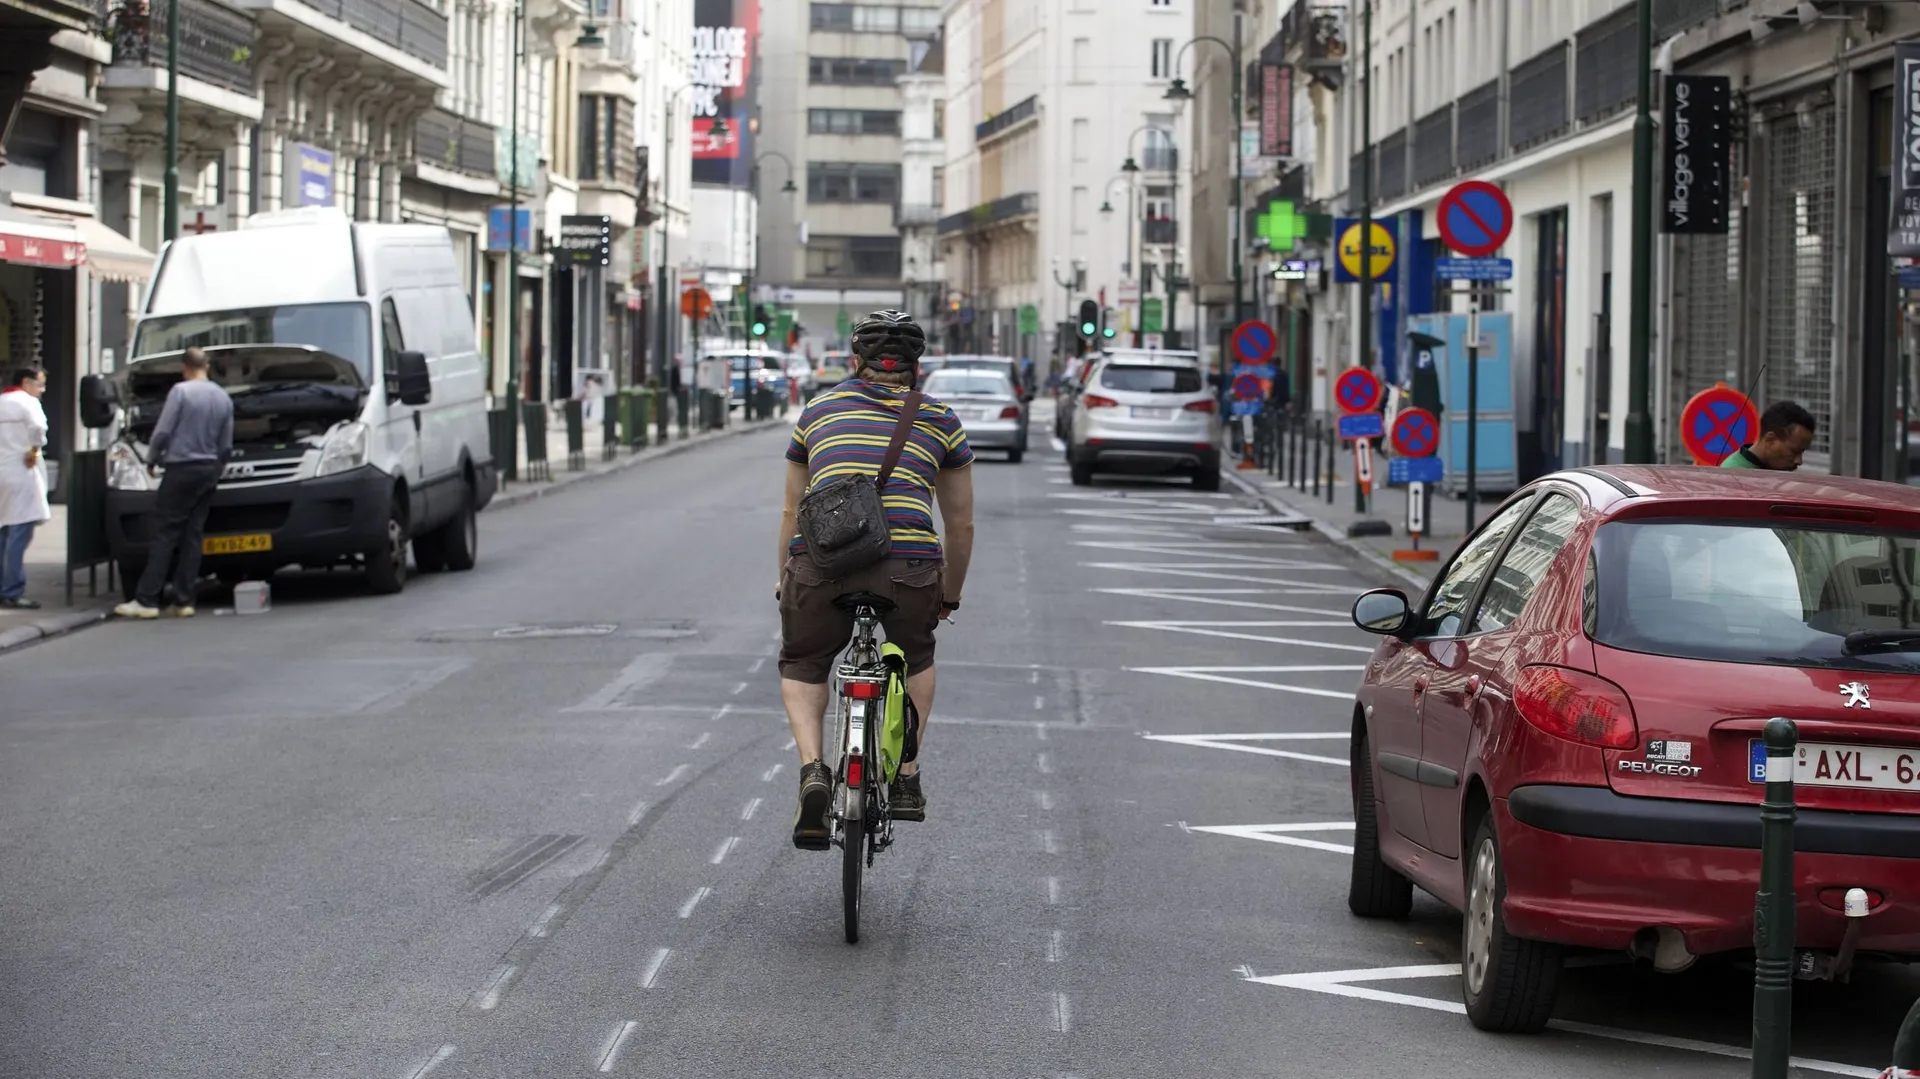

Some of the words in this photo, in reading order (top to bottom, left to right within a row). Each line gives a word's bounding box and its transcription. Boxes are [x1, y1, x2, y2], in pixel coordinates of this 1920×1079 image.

[1675, 82, 1690, 150] verve
[1668, 153, 1694, 226] village
[1618, 759, 1702, 778] PEUGEOT
